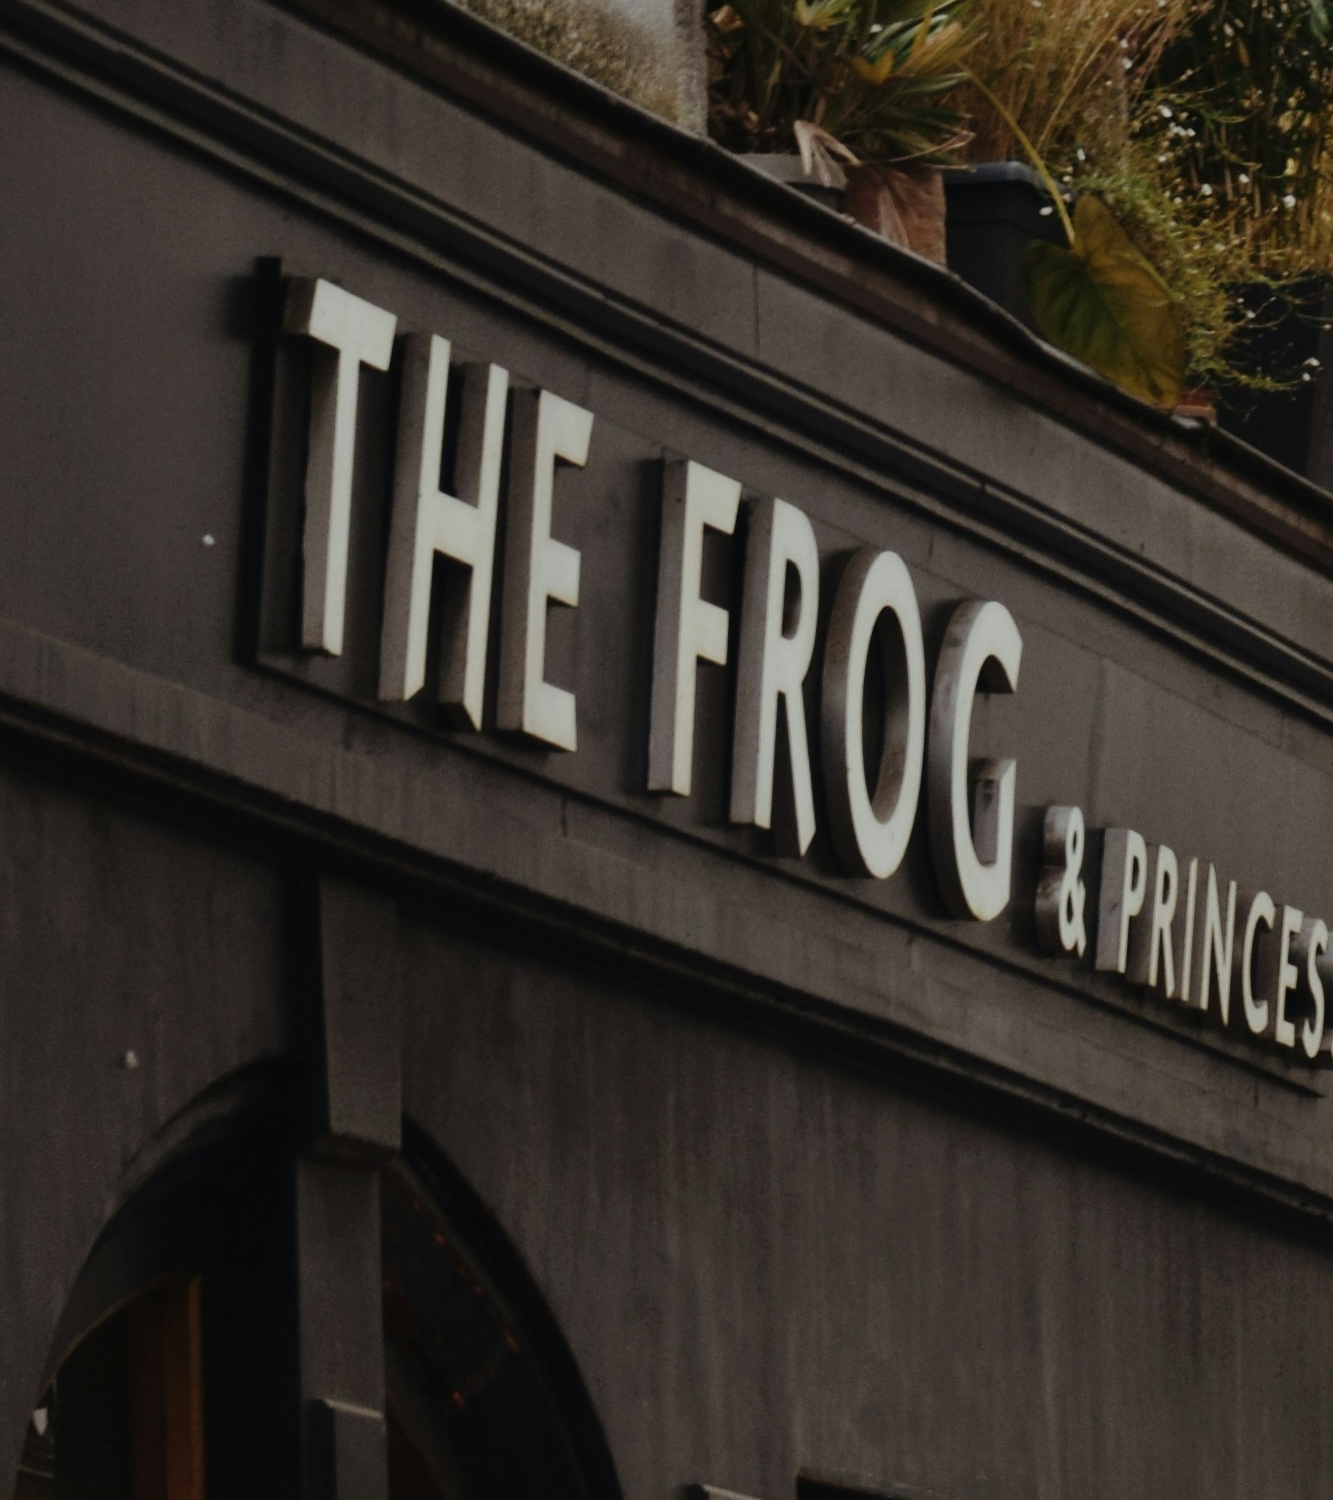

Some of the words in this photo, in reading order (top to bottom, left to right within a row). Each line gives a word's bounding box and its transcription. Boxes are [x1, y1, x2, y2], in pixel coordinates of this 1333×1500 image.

[283, 275, 595, 753] THE
[648, 458, 1023, 921] FROG
[1036, 805, 1087, 957] &
